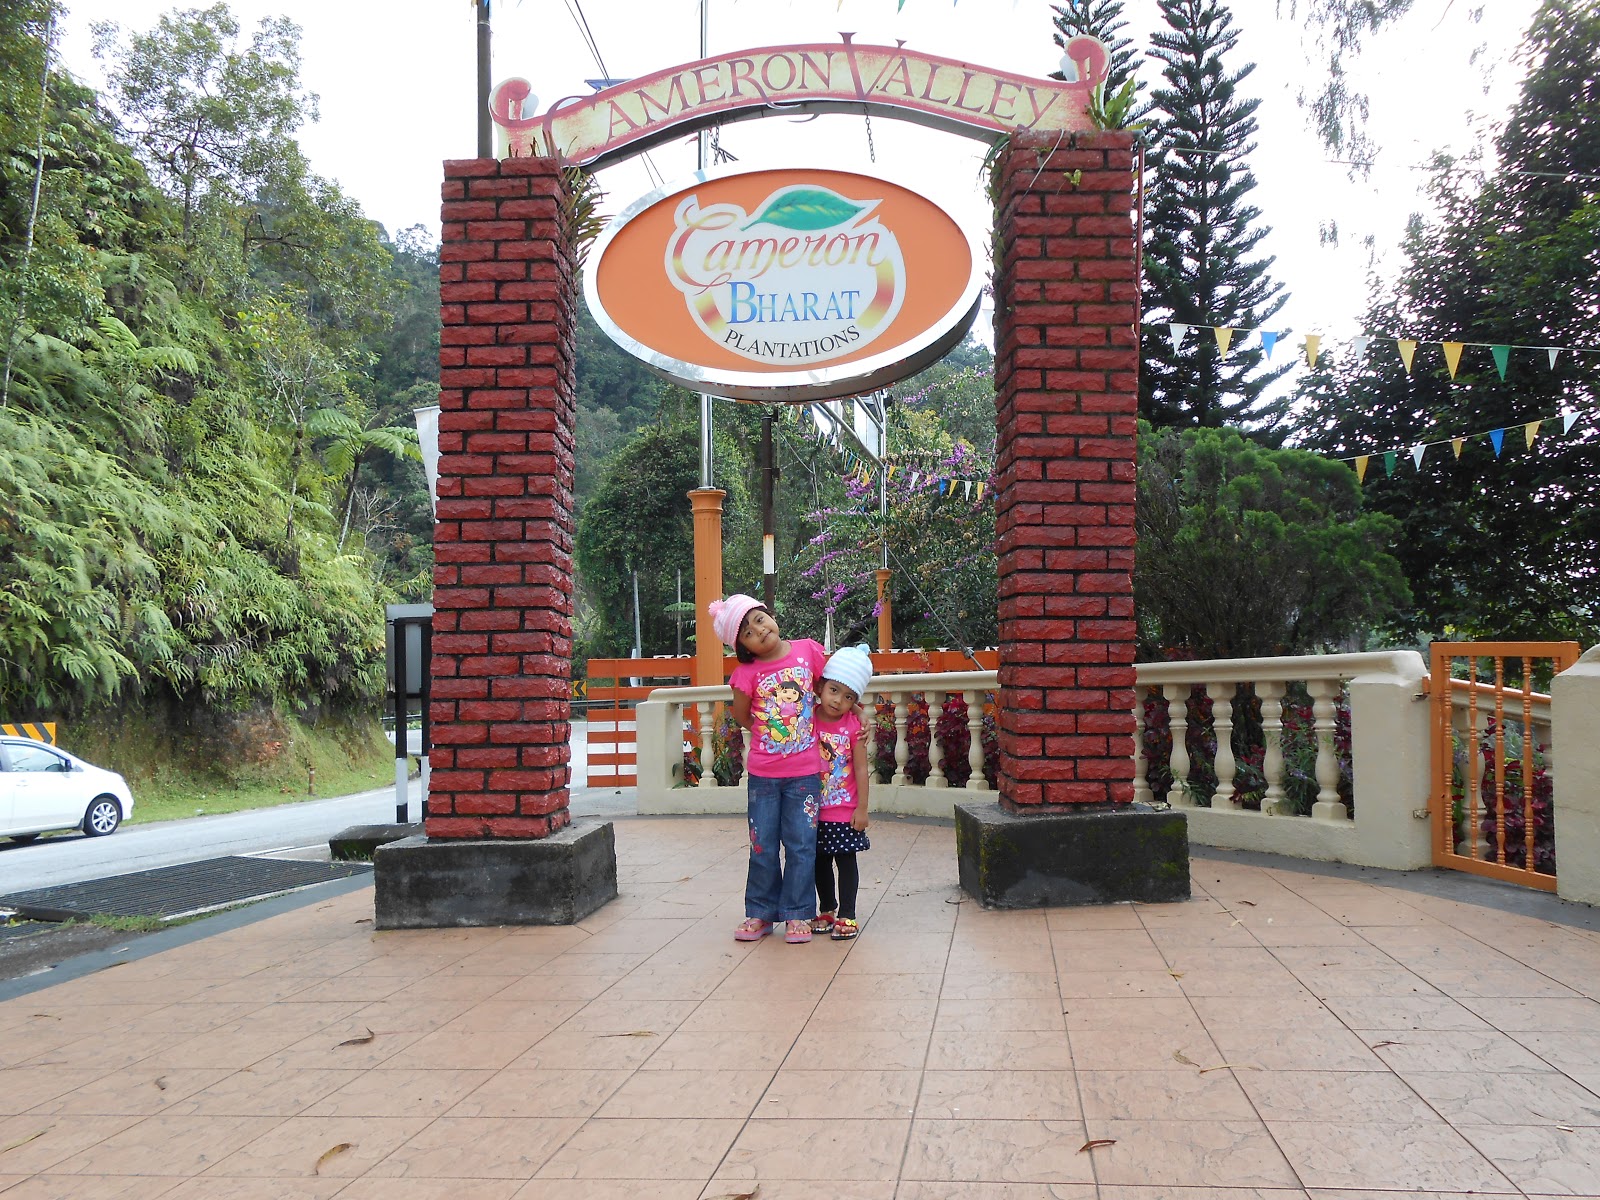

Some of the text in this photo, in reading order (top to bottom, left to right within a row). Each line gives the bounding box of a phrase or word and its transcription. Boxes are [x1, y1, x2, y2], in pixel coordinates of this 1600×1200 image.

[541, 31, 1061, 168] CAMERON VALLEY
[672, 203, 888, 296] Cameron
[725, 281, 861, 325] BHARAT
[723, 325, 861, 358] PLANTATIONS
[756, 673, 778, 698] BEST
